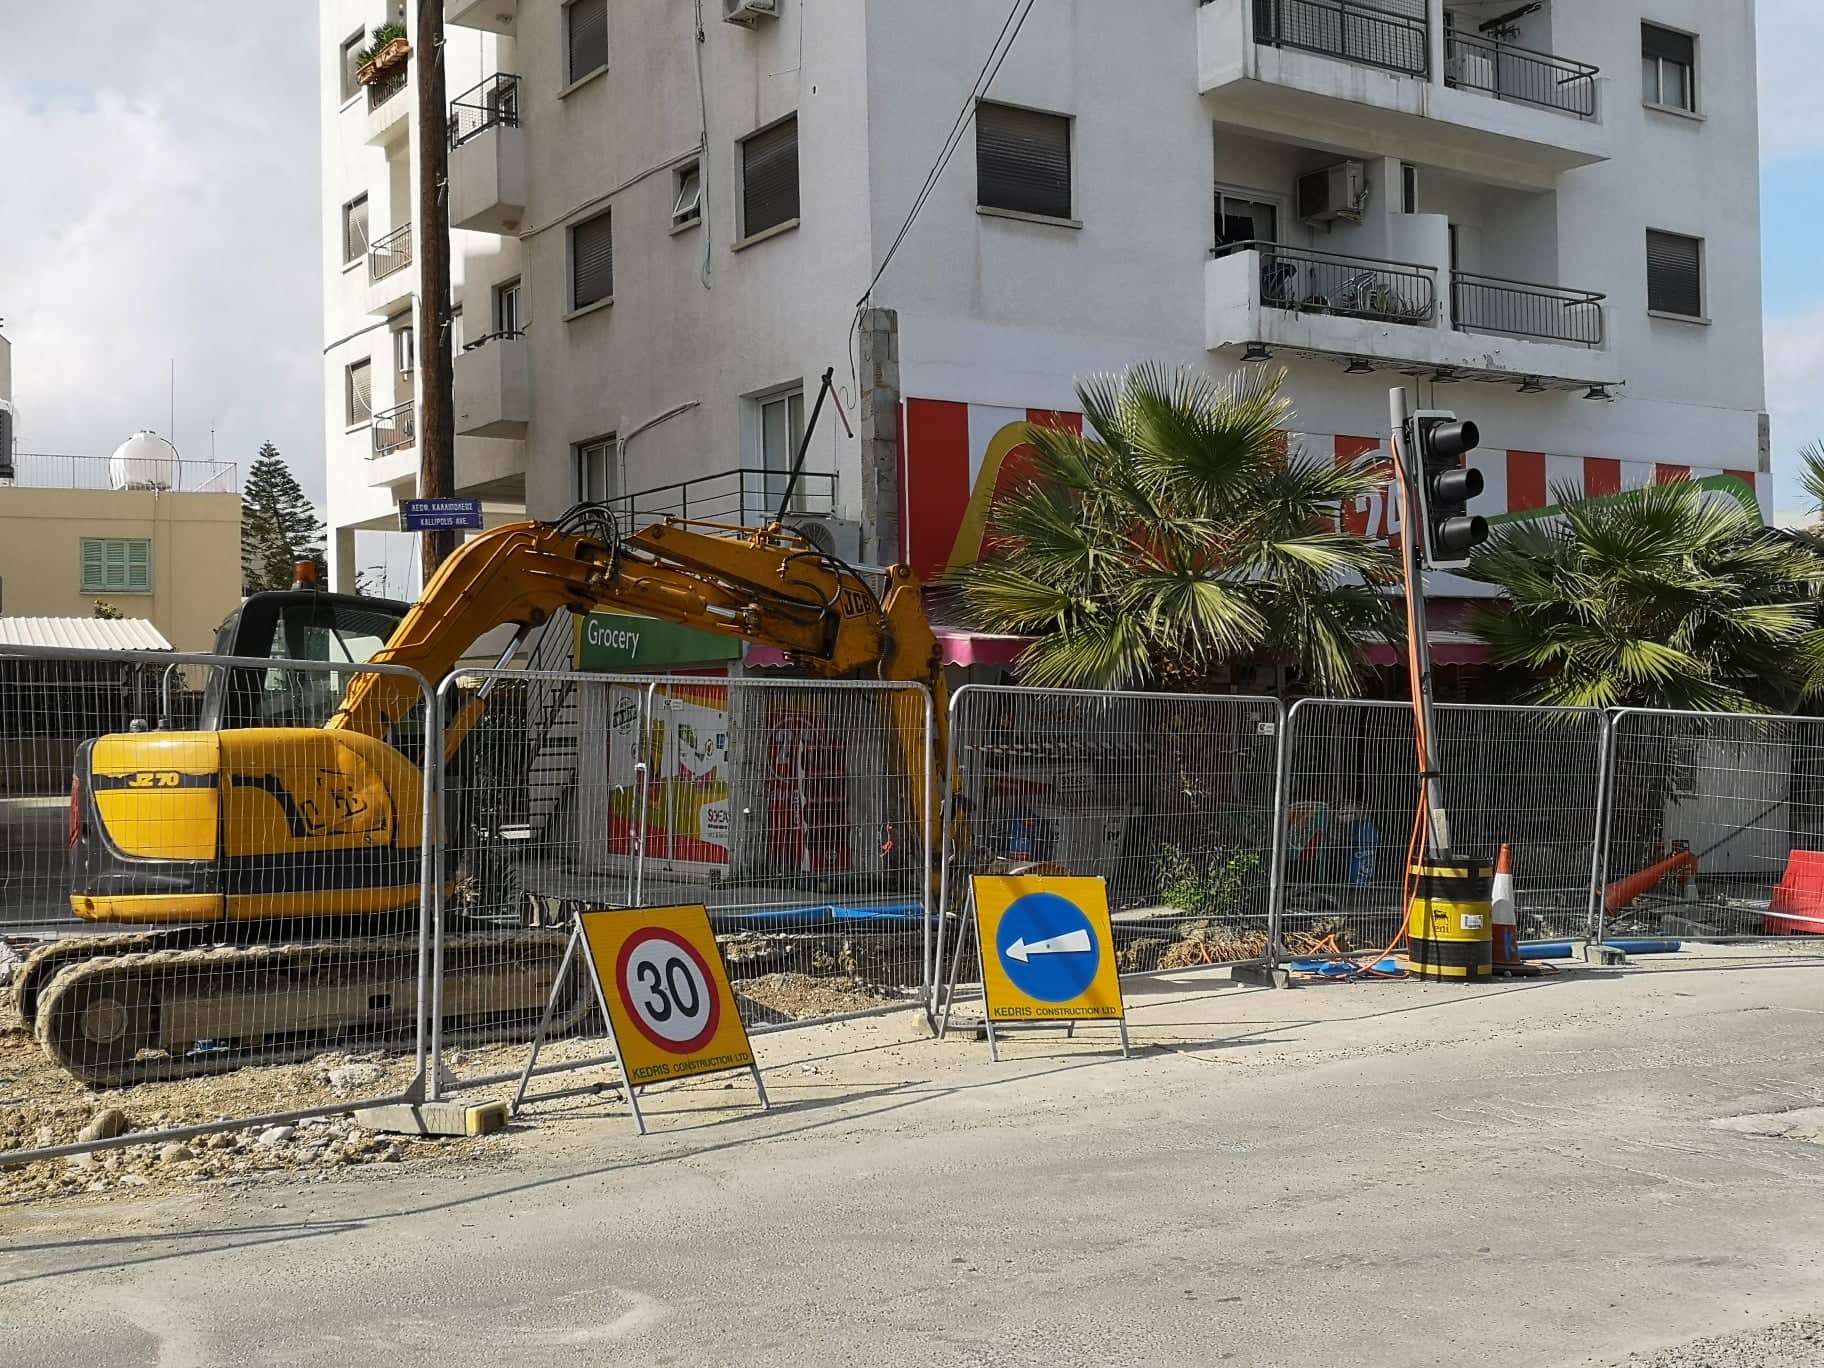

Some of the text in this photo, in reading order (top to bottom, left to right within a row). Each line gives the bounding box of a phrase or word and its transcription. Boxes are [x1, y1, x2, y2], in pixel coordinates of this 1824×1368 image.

[420, 517, 470, 526] KALLIPOLIS AVE.
[844, 591, 873, 616] JCB
[587, 619, 640, 659] Grocery
[155, 772, 179, 786] 70
[1434, 923, 1449, 933] eni
[637, 956, 700, 1023] 30
[994, 1006, 1116, 1017] KEDRIS CONSTRUCTION LTD
[632, 1052, 749, 1080] KEDRIS CONSTRUCTION LTD
